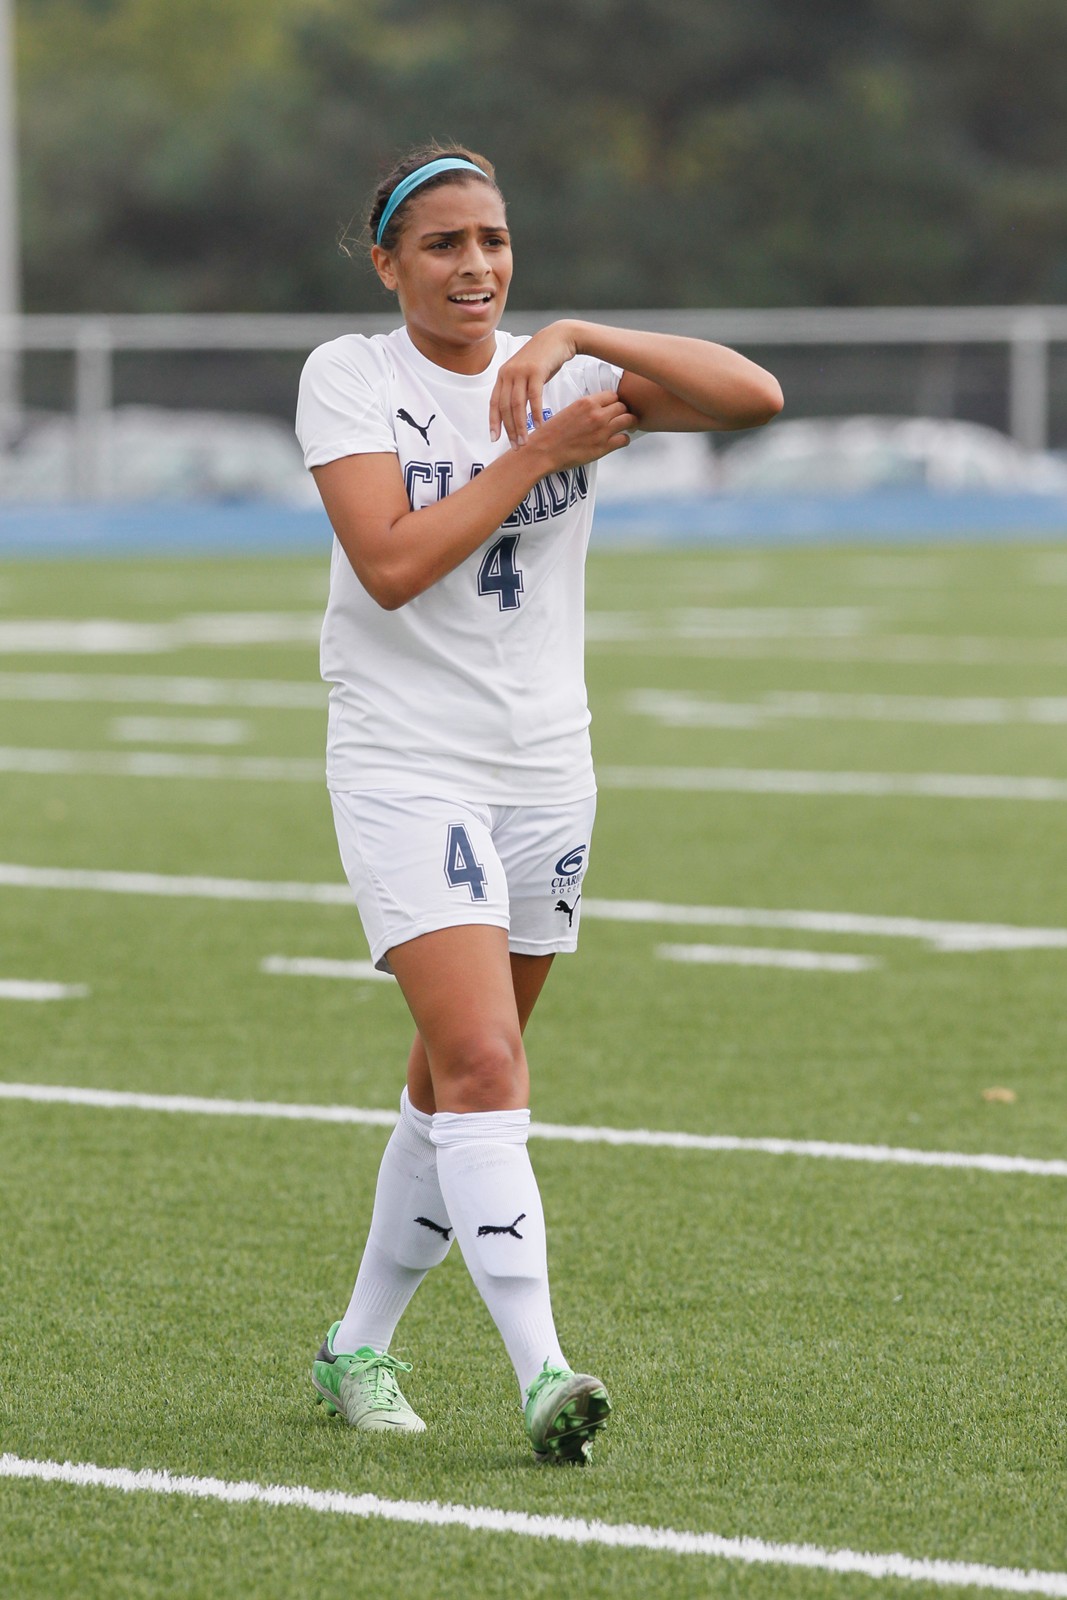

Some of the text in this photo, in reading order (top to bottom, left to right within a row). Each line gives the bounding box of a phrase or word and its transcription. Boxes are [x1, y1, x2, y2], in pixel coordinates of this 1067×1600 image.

[404, 460, 588, 528] CLION
[477, 534, 524, 612] 4
[444, 823, 488, 901] 4
[551, 883, 579, 894] SOCC
